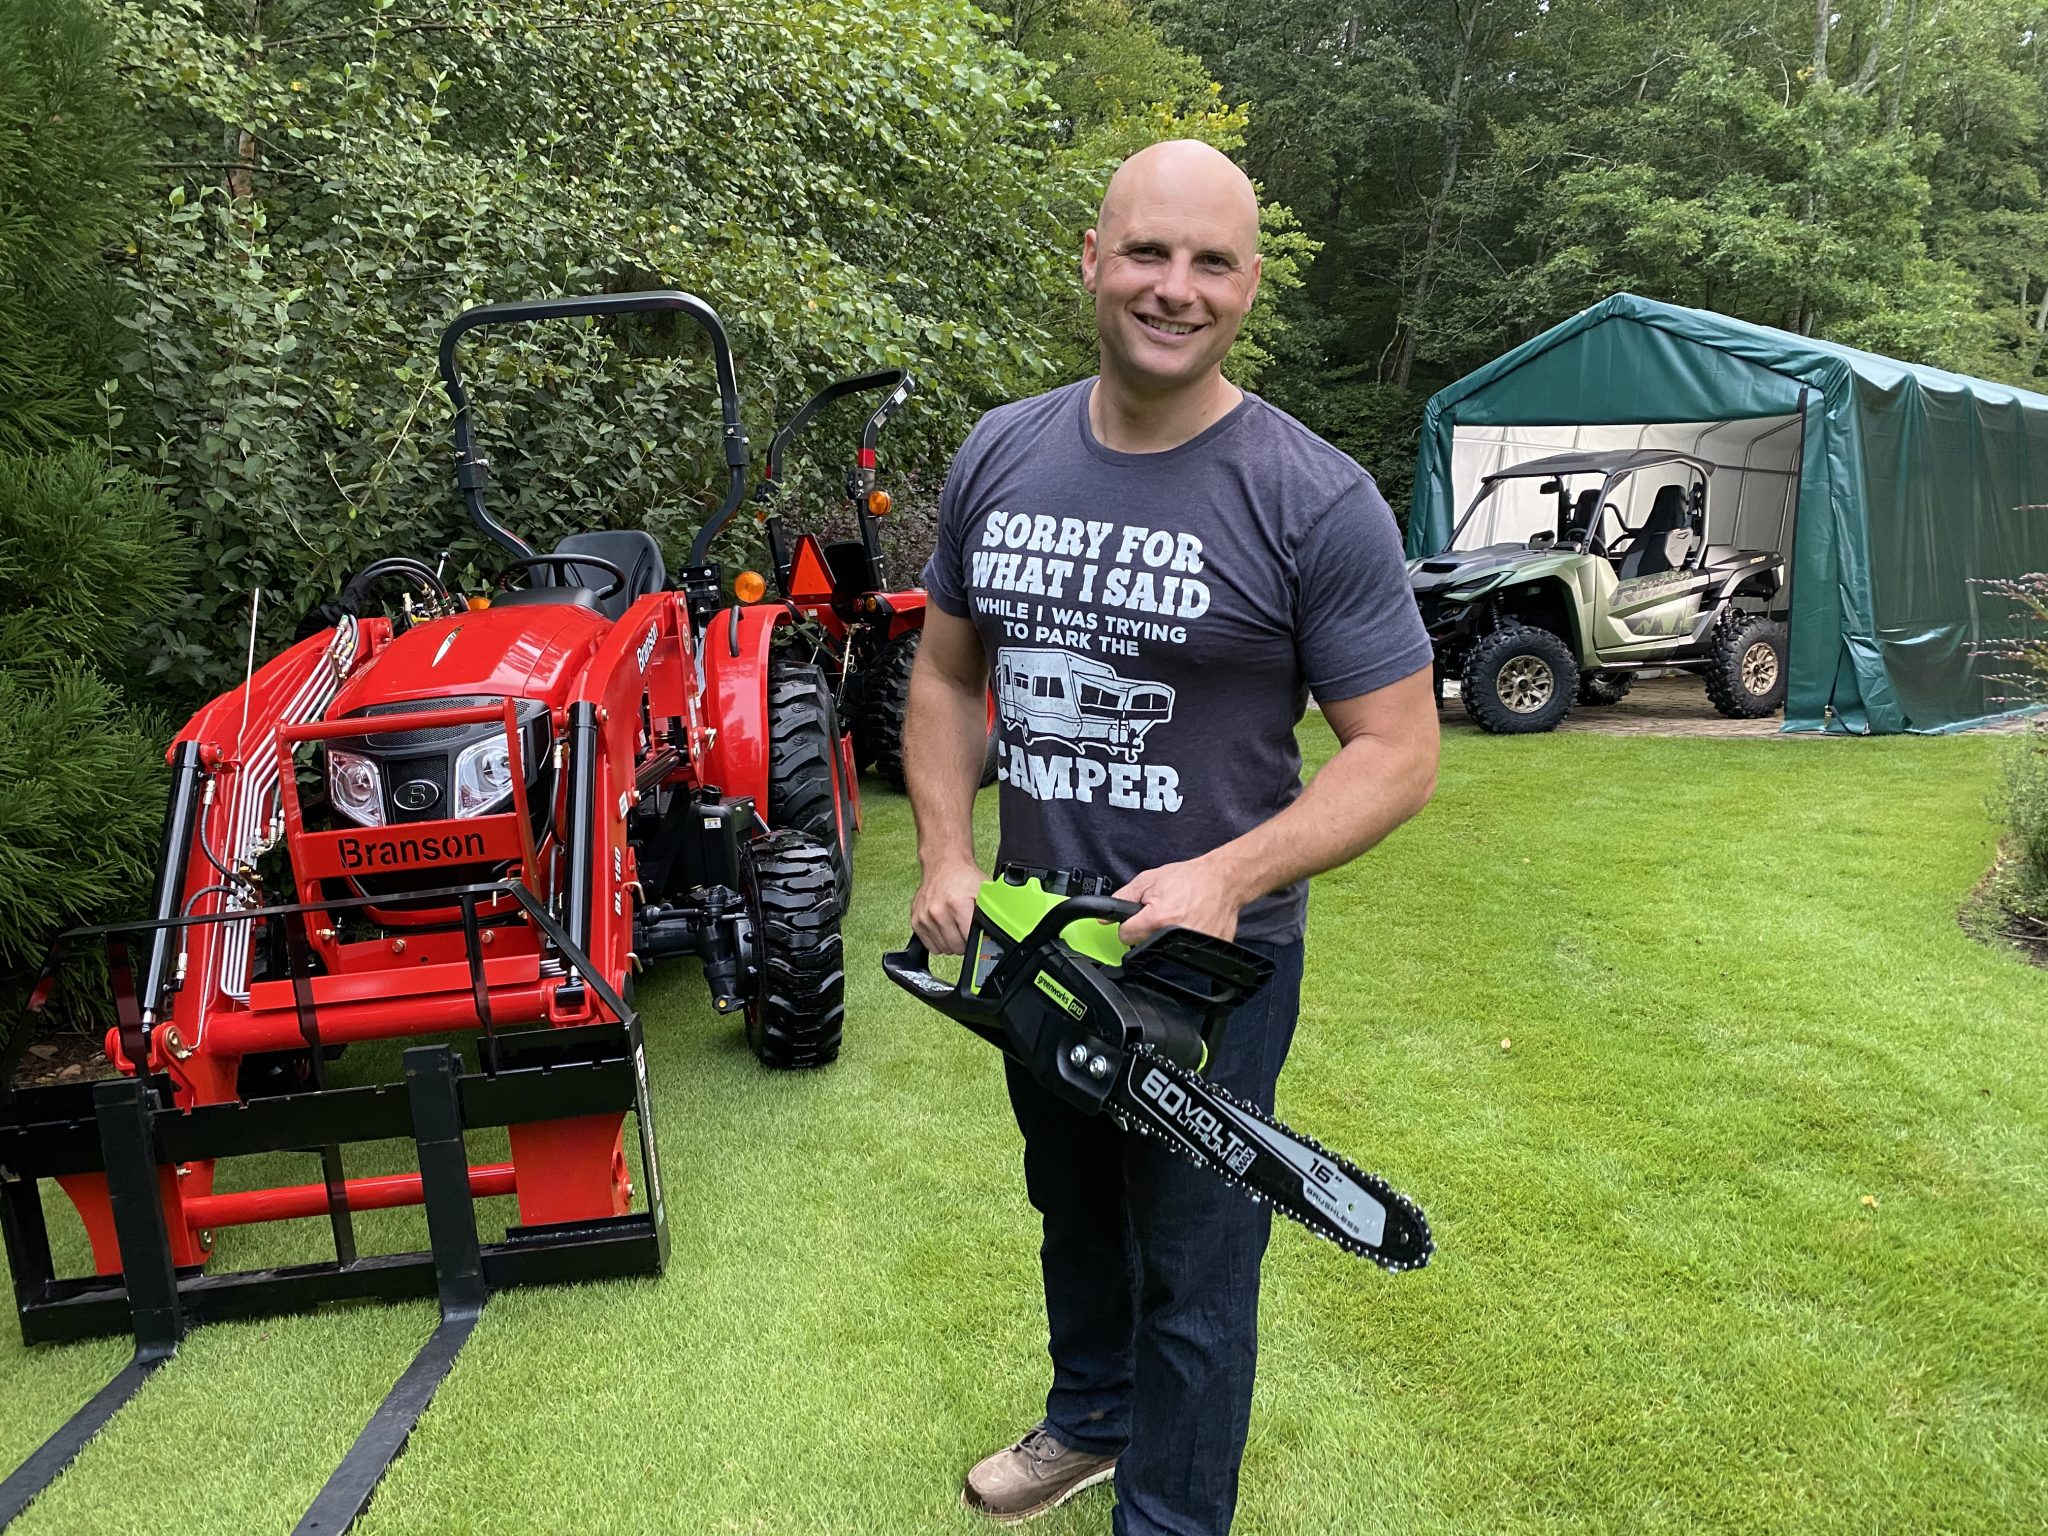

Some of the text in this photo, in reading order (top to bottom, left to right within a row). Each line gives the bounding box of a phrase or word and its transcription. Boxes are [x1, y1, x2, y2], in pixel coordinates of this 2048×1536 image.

[982, 511, 1205, 574] SORRY FOR
[972, 551, 1211, 619] WHAT I SAID
[976, 597, 1187, 644] WHILE I WAS TRYING
[1003, 620, 1140, 657] TO PARK THE
[636, 620, 659, 675] Branson
[409, 784, 426, 804] B
[338, 832, 485, 869] Branson
[1037, 976, 1084, 1016] greenworks pro
[1141, 1068, 1245, 1152] 60 VOLT
[1176, 1110, 1229, 1160] LITHIUM
[1234, 1149, 1256, 1173] MAX
[1306, 1187, 1360, 1234] BRUSHLESS
